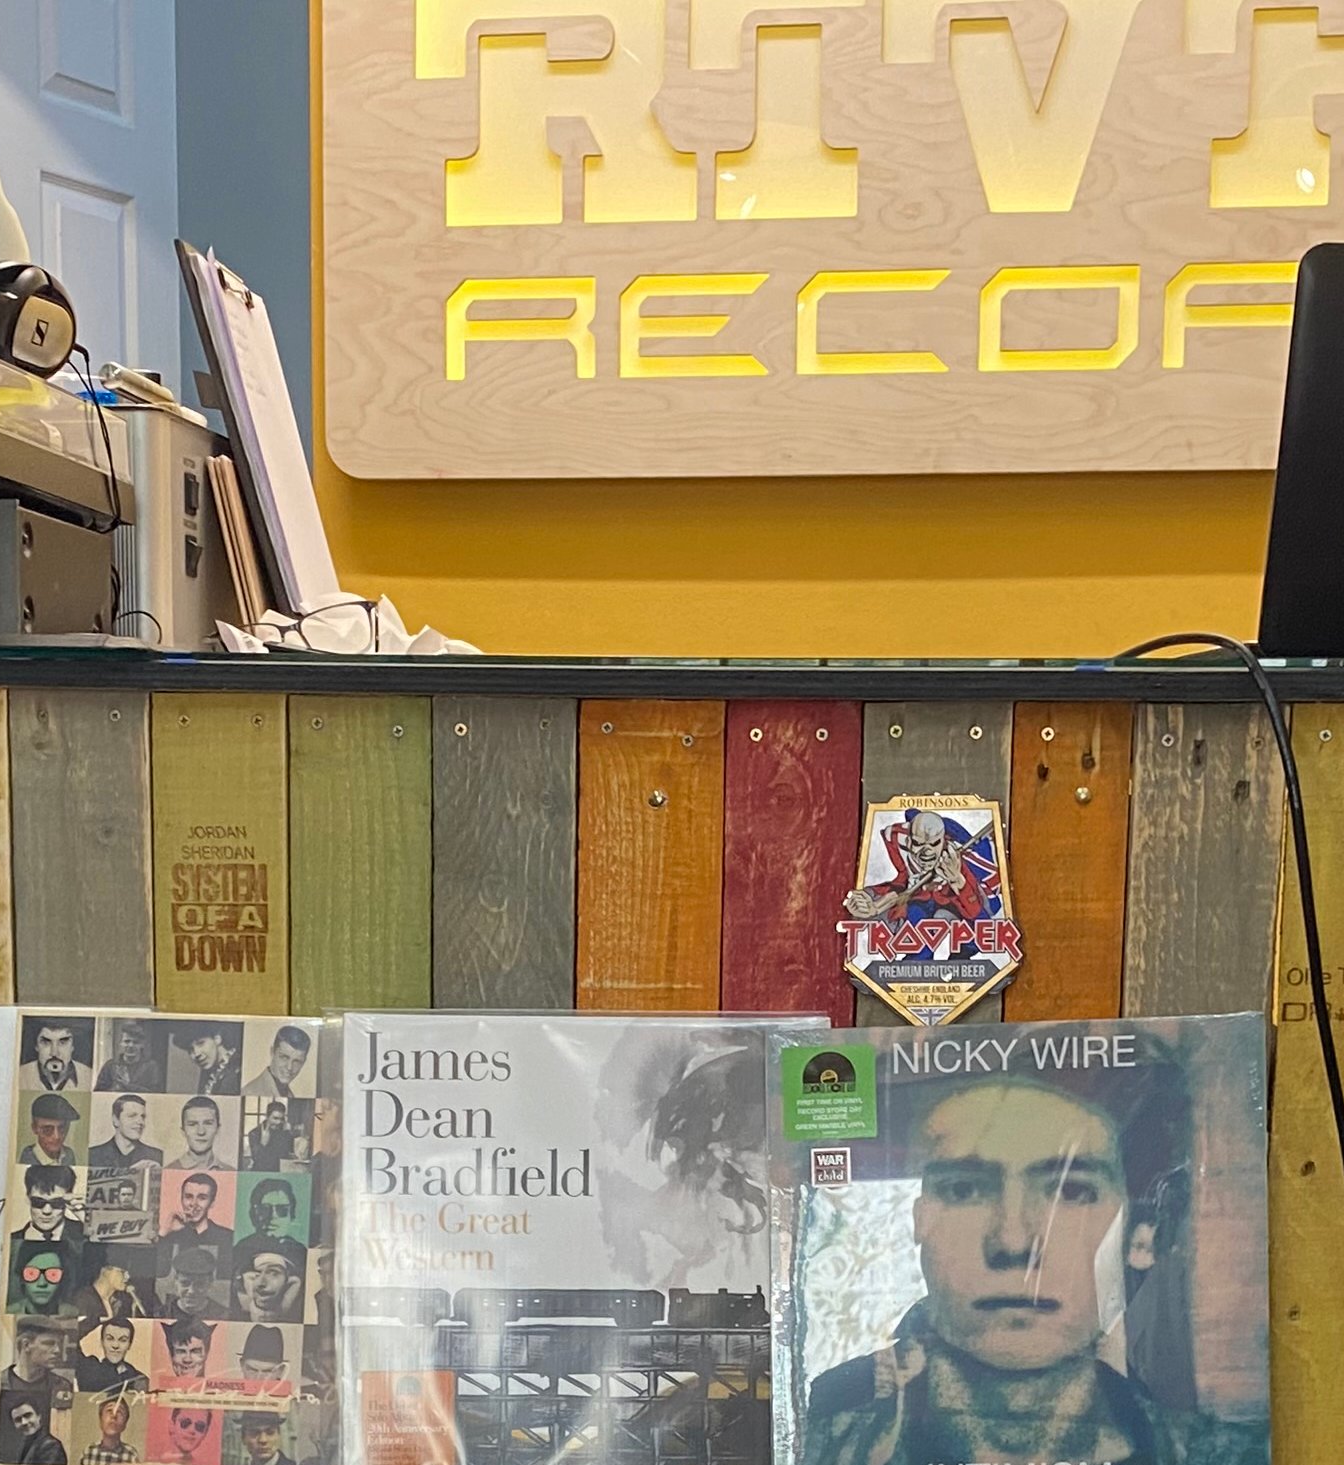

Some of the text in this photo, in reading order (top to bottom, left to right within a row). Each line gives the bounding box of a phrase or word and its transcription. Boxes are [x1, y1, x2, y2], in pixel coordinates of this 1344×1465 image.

[446, 260, 1298, 381] RECOR
[899, 797, 969, 808] ROBINSONS
[187, 825, 248, 840] JORDAN
[181, 845, 255, 860] SHERIDAN
[170, 863, 268, 902] SYSTEM
[176, 905, 265, 931] OF A
[174, 935, 267, 973] DOWN
[839, 918, 1024, 963] TROOPER
[878, 964, 986, 979] PREMIUM BRITISH BEER
[1286, 967, 1333, 986] Ole
[931, 985, 962, 994] ENGLAND
[357, 1031, 512, 1084] James
[892, 1034, 1137, 1075] NICKY WIRE
[360, 1089, 497, 1139] Dean
[360, 1147, 594, 1197] Bradfield
[816, 1154, 844, 1166] WAR
[818, 1169, 844, 1182] child
[360, 1200, 534, 1236] The Great
[361, 1237, 495, 1272] Western
[205, 1381, 246, 1391] MADNESS
